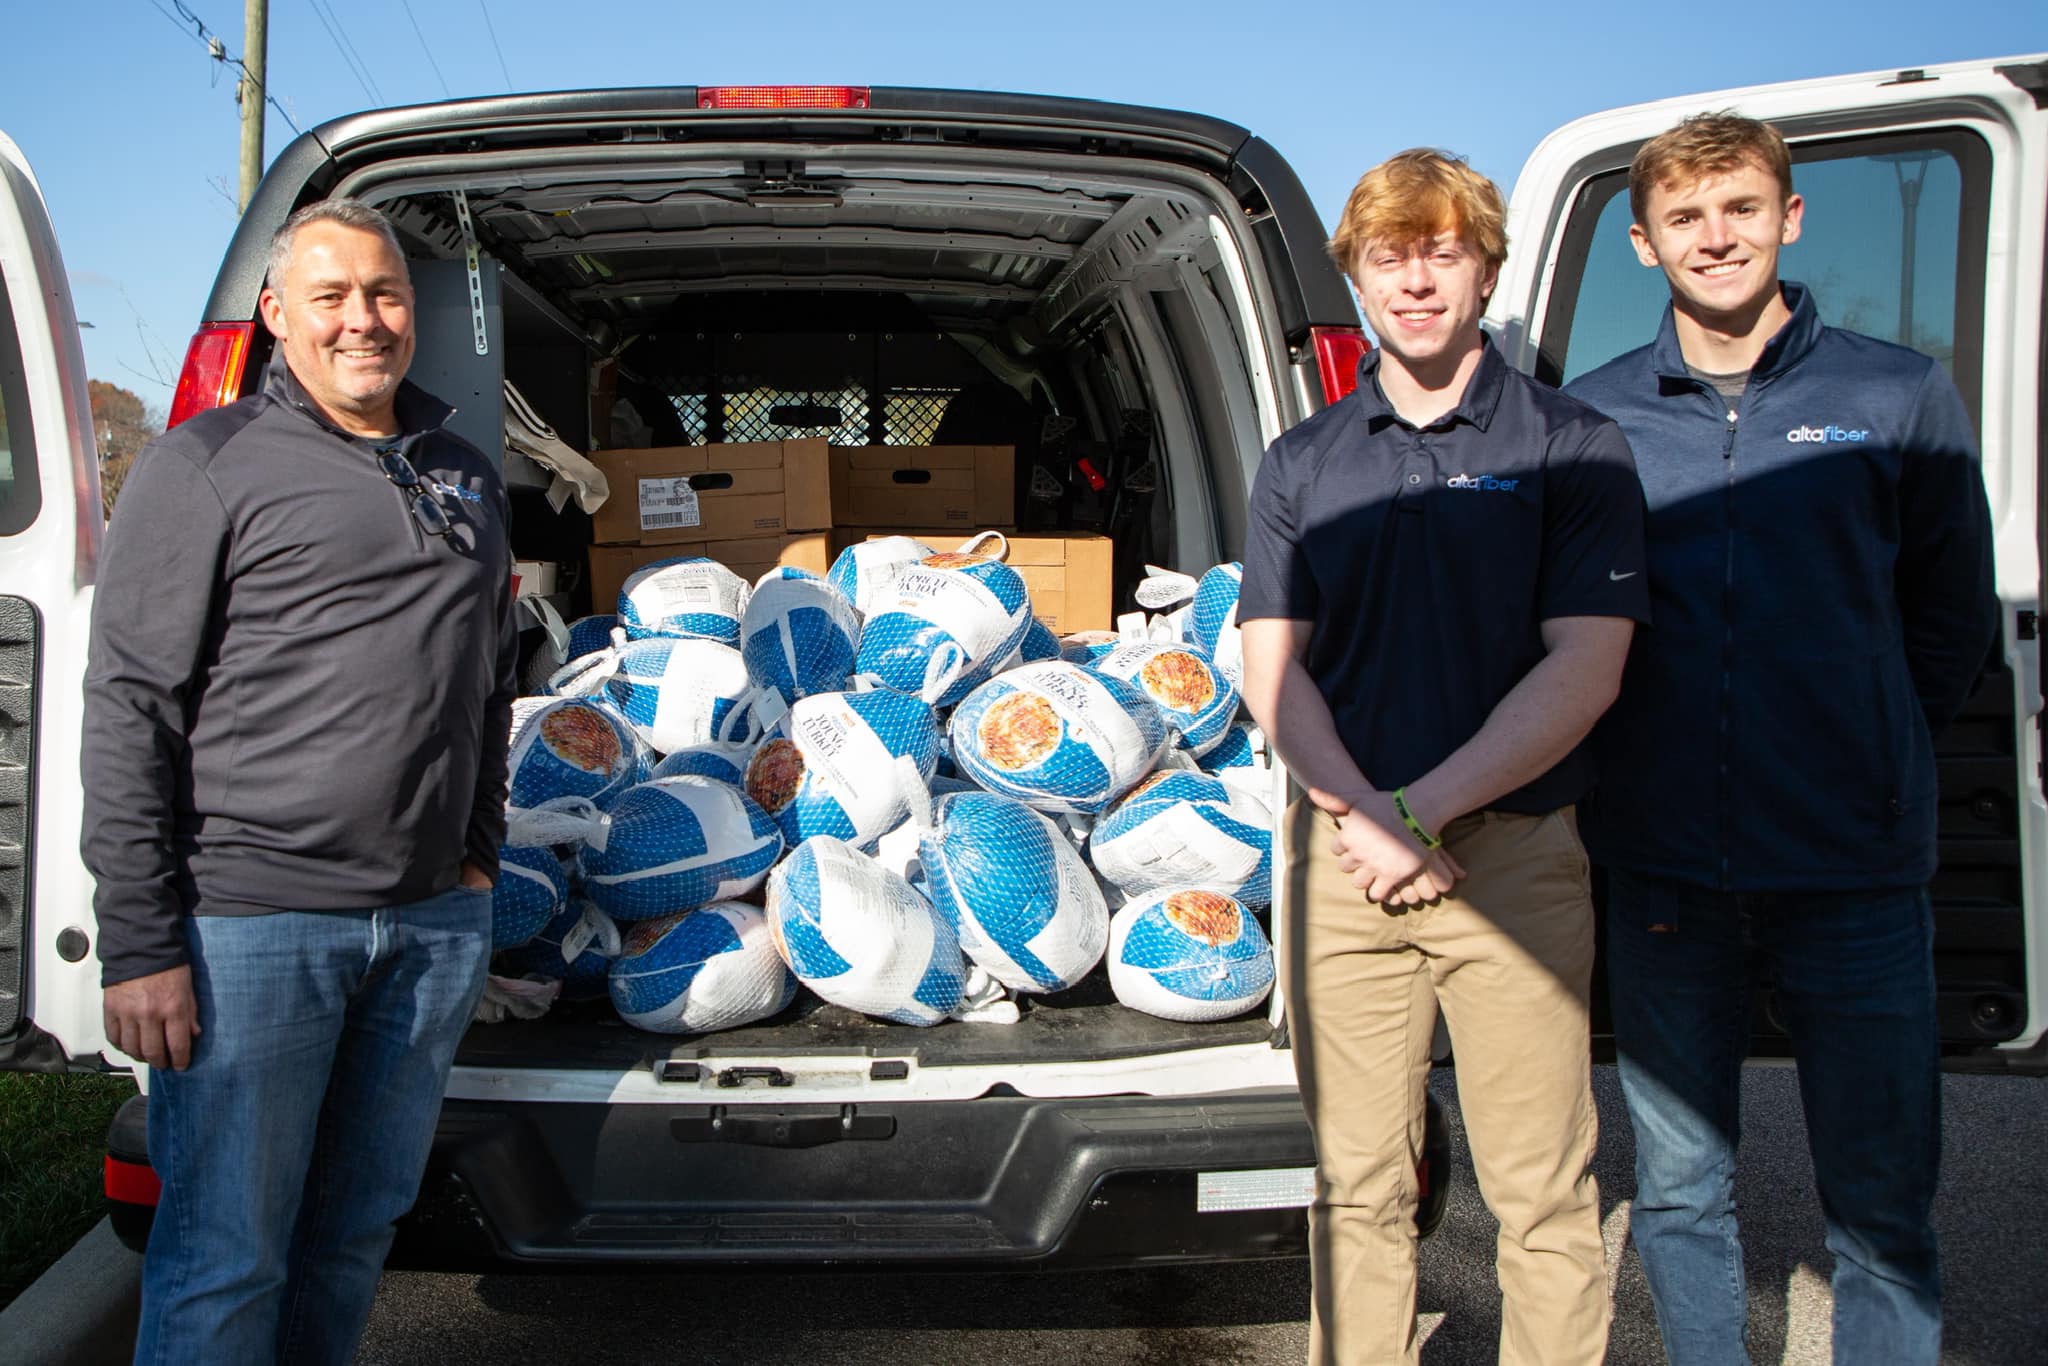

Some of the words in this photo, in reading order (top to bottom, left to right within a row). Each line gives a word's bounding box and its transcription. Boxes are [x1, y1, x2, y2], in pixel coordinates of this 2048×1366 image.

[1785, 425, 1869, 443] altafiber
[1447, 473, 1519, 491] altafiber
[802, 717, 840, 757] TURKEY
[816, 713, 847, 749] YOUNG
